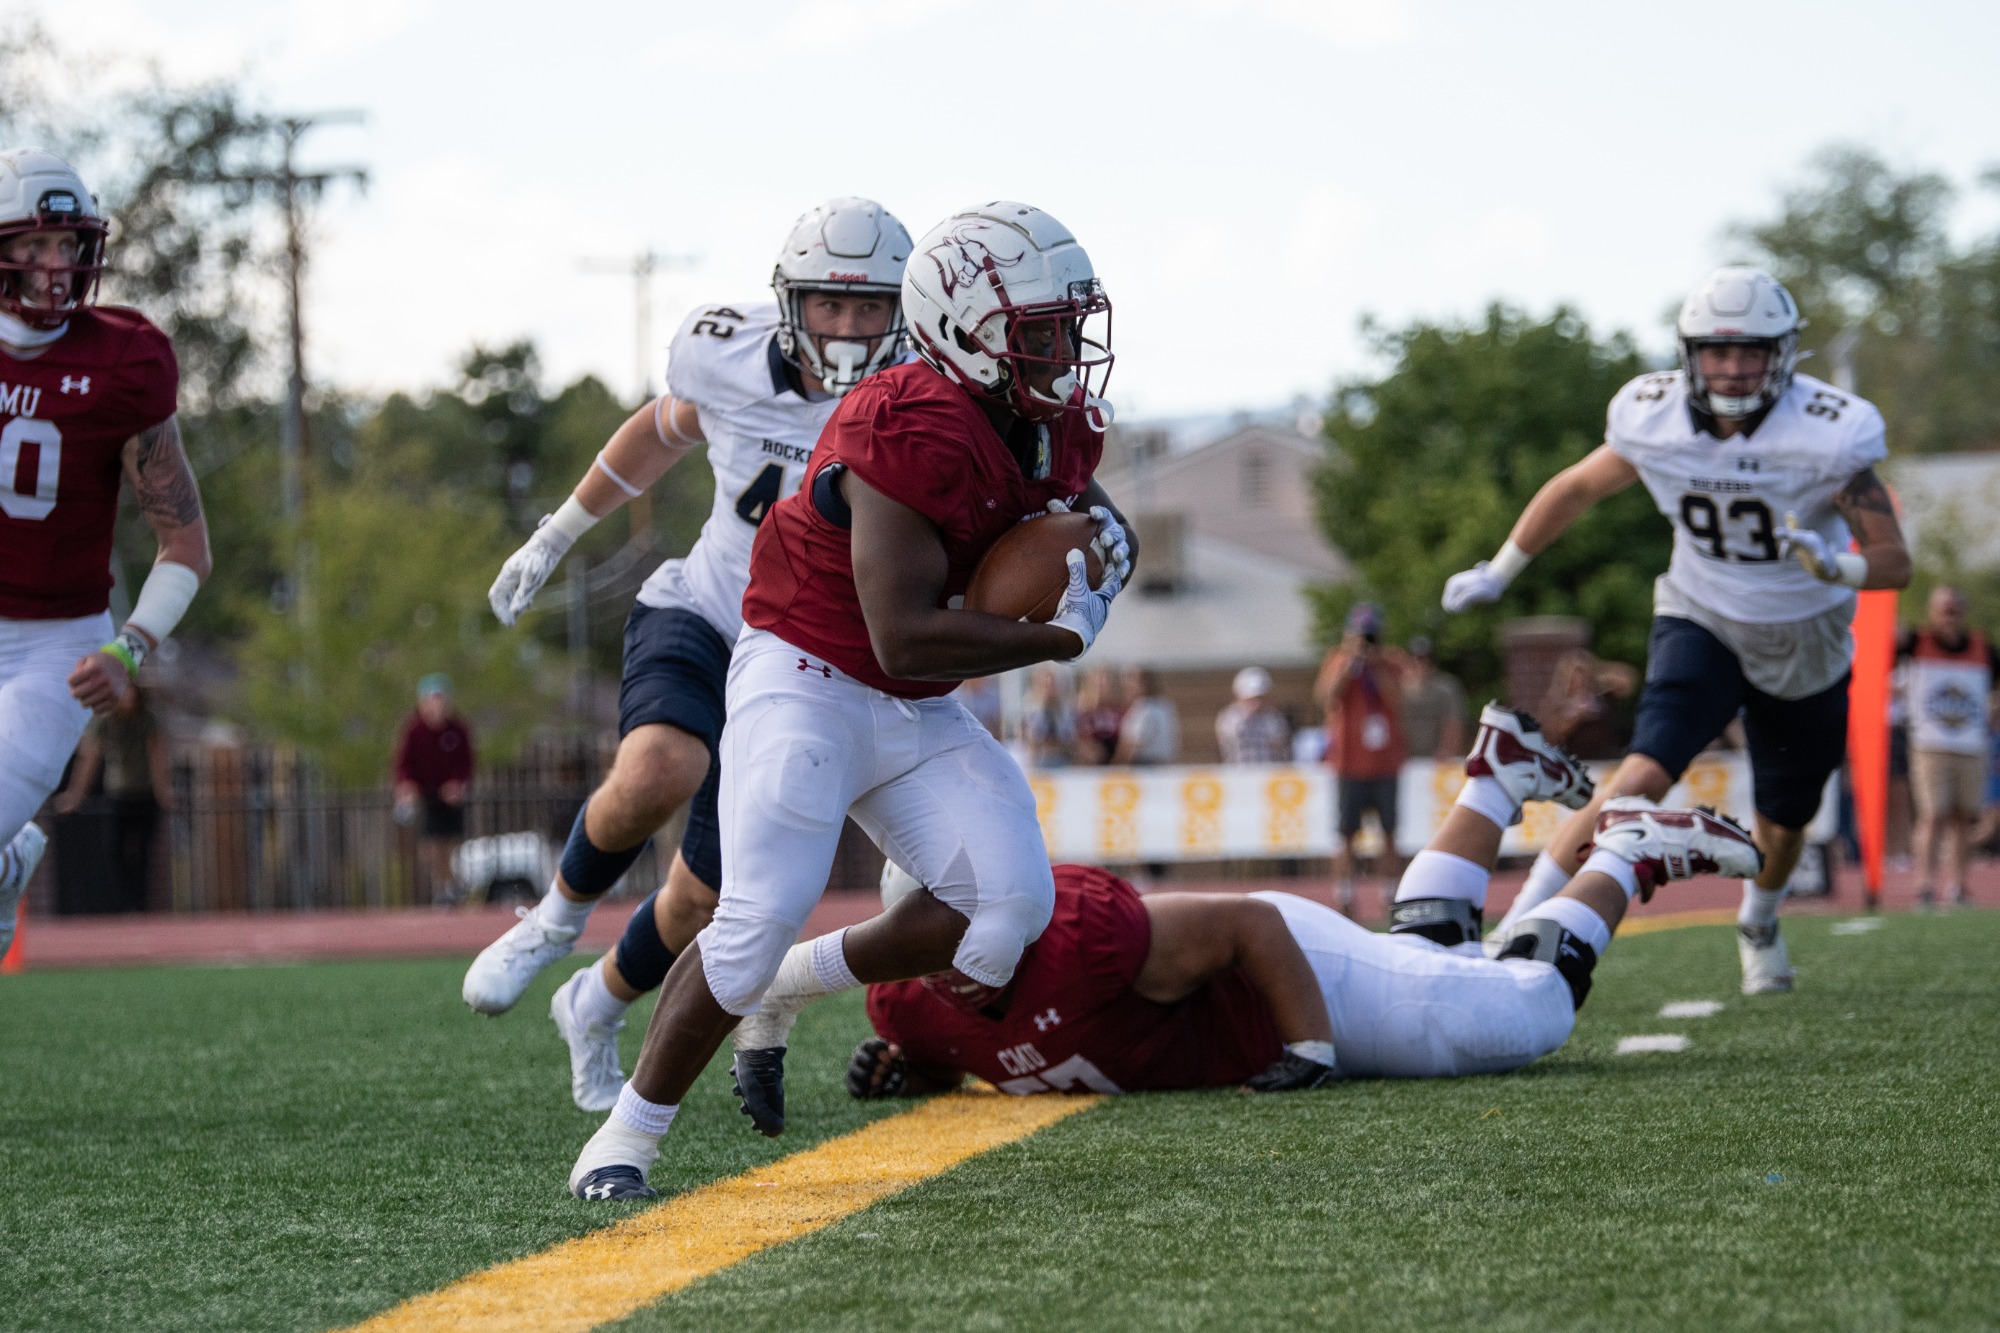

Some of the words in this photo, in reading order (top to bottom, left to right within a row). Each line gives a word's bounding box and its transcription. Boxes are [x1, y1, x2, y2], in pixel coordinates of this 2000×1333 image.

[691, 306, 746, 339] 42
[0, 417, 62, 520] 0
[734, 460, 804, 527] 4
[1679, 492, 1780, 563] 93
[996, 1042, 1048, 1077] CMU
